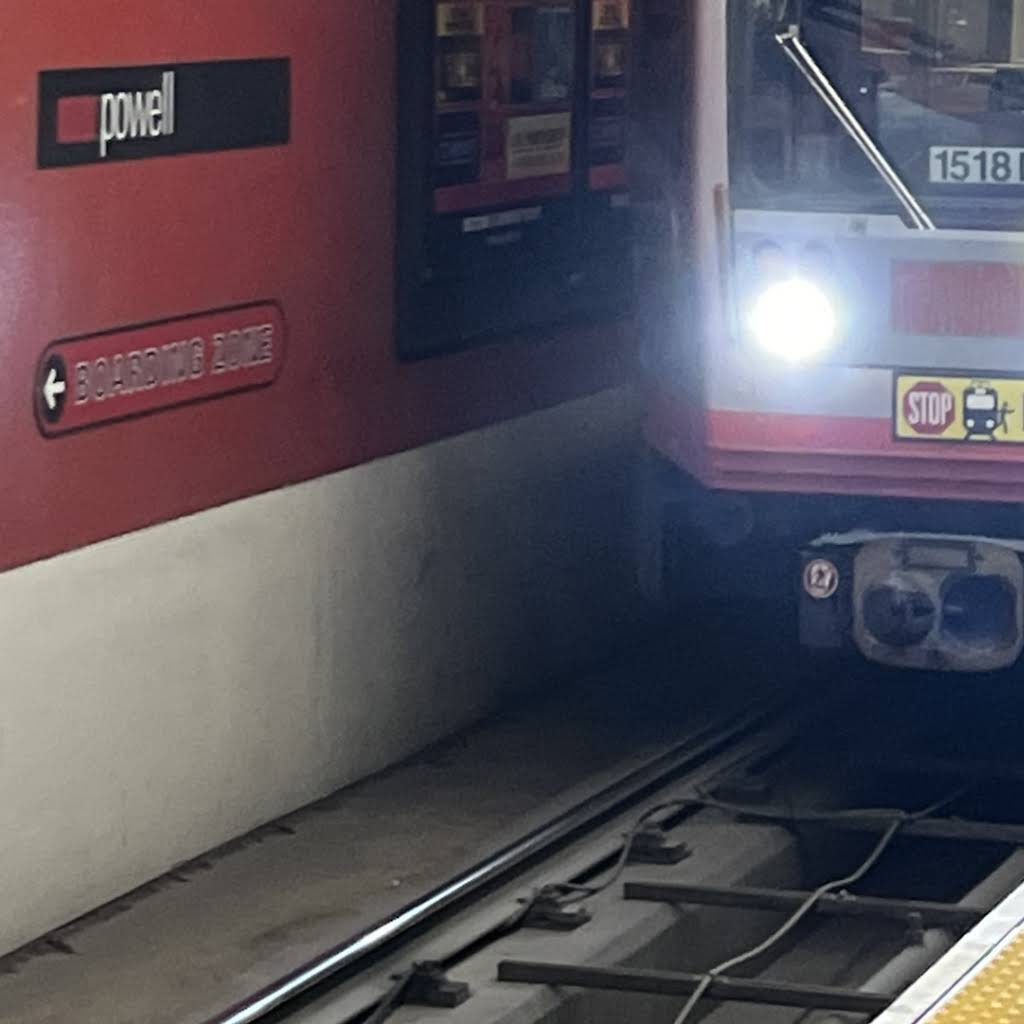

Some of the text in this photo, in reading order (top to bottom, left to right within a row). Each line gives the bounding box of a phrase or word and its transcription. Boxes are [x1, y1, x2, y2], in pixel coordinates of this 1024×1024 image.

[100, 71, 175, 157] powell
[74, 324, 273, 404] BOARDING ZONE
[908, 392, 952, 425] STOP
